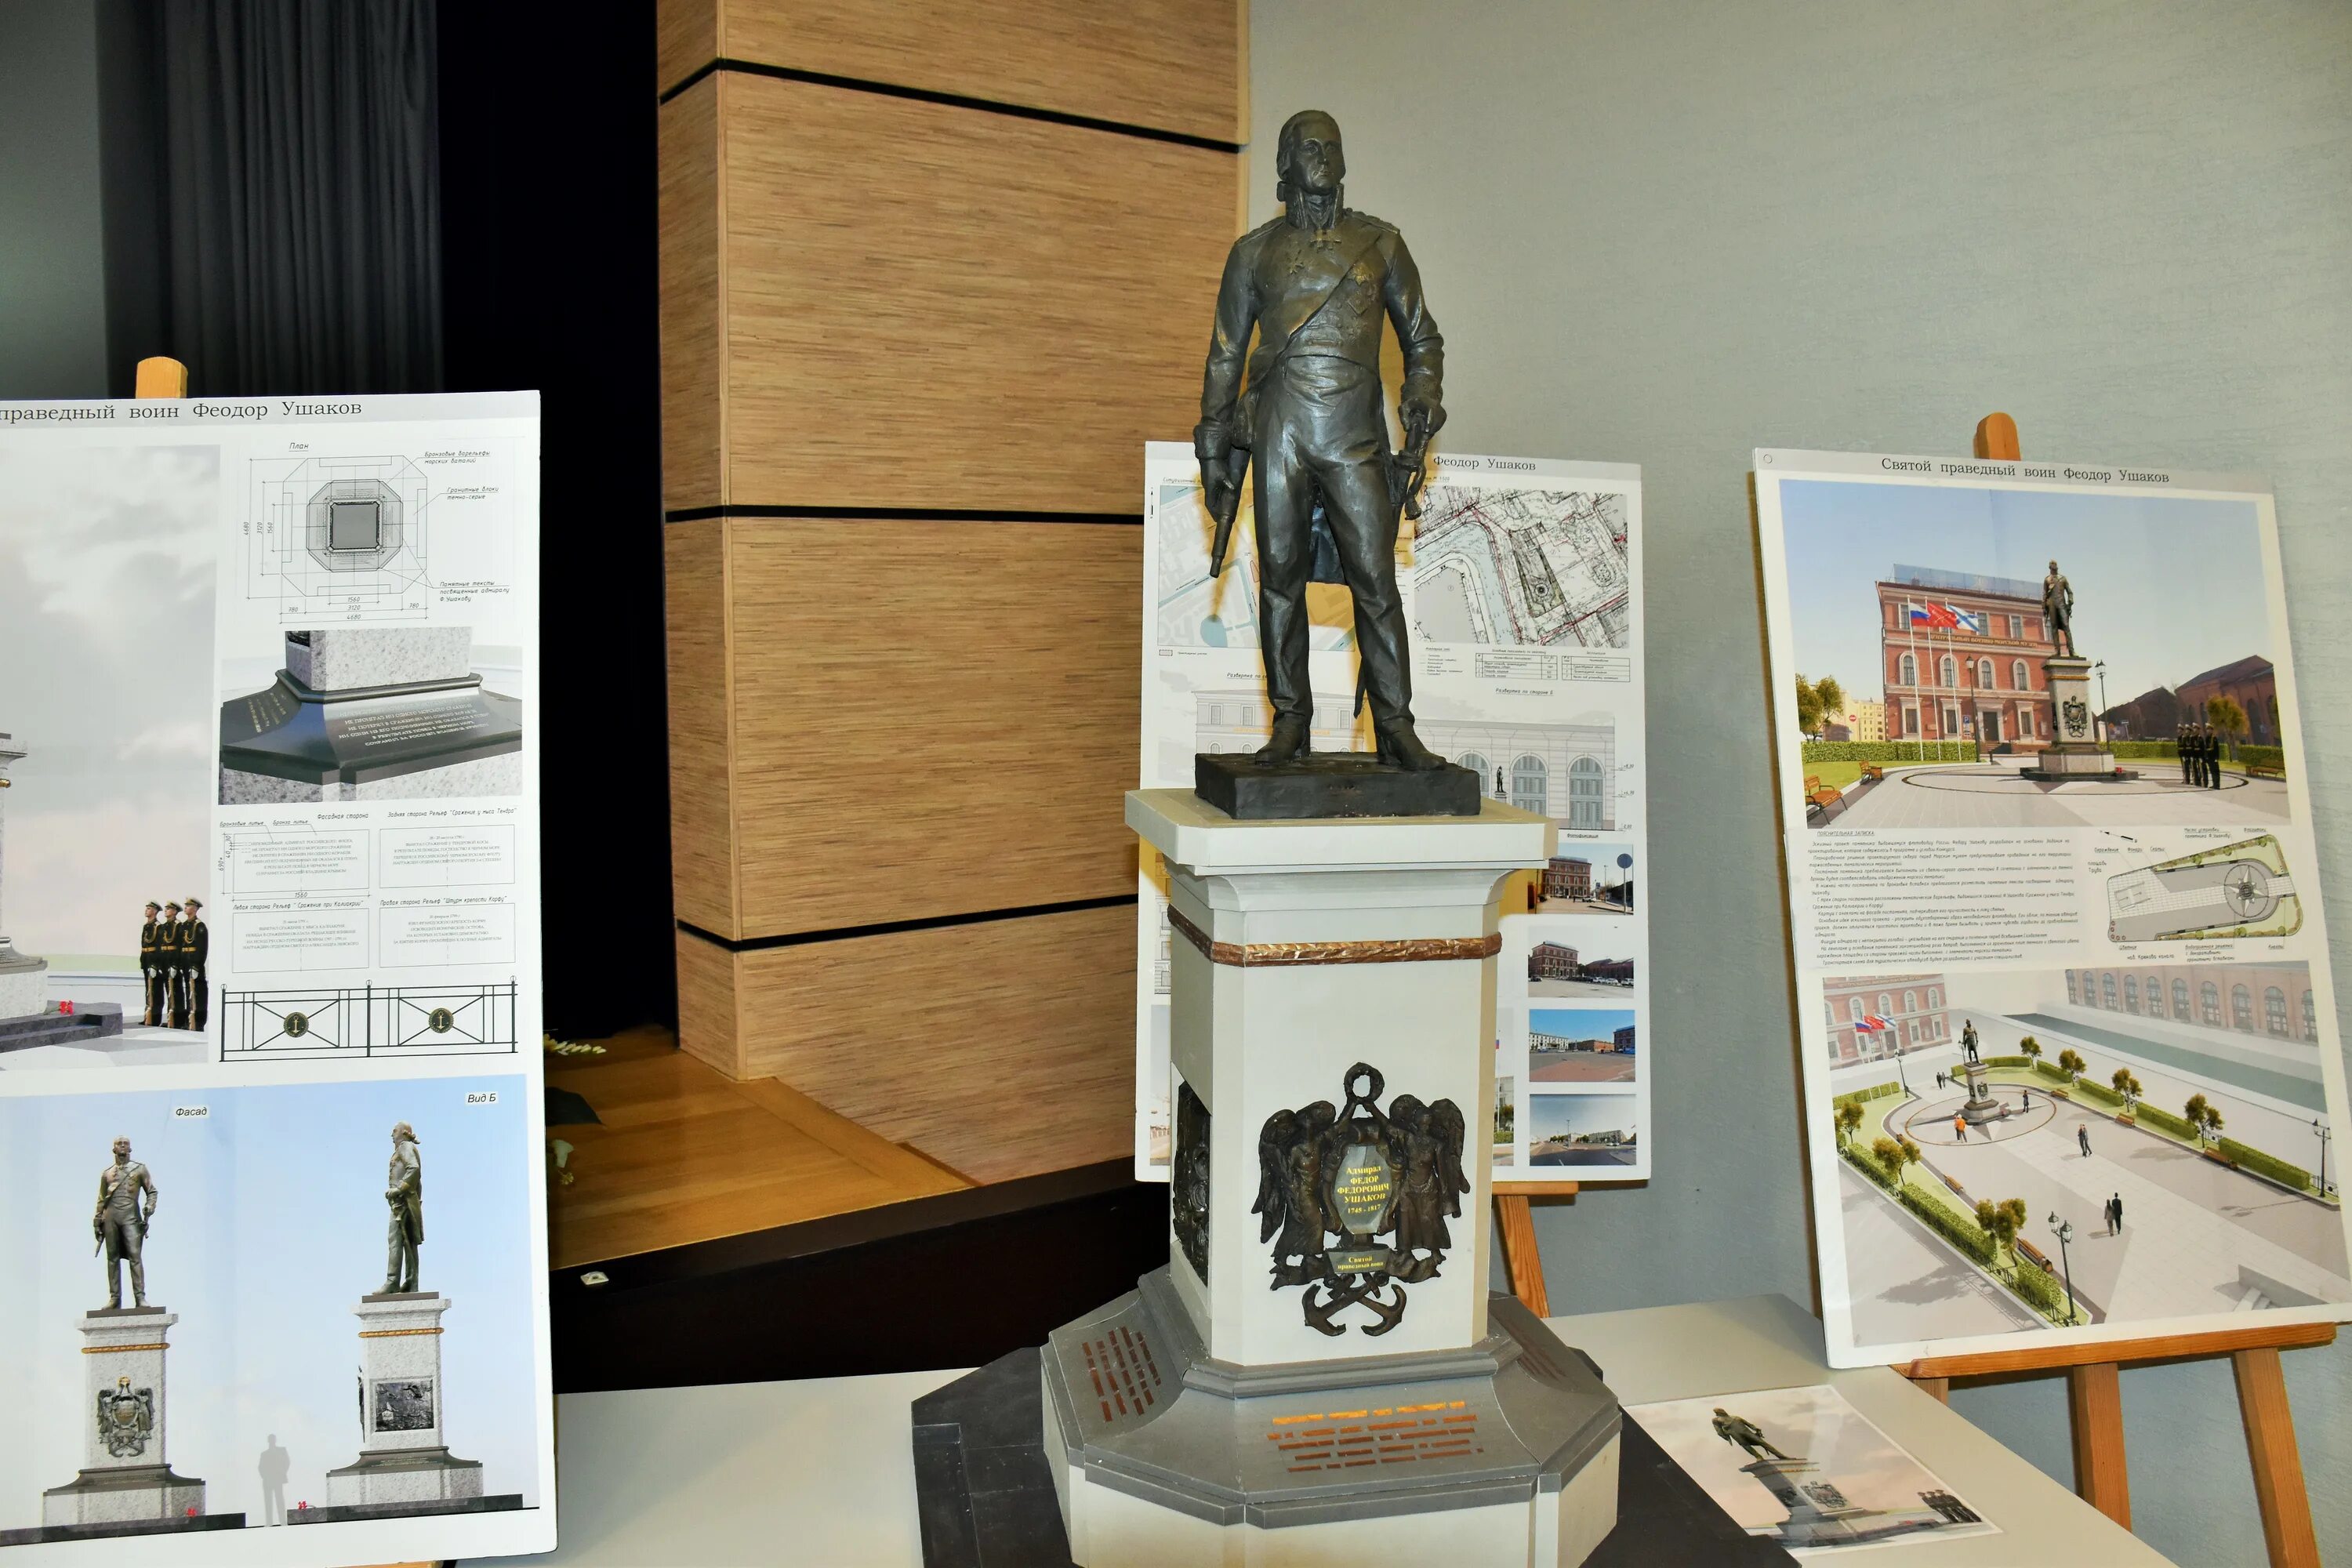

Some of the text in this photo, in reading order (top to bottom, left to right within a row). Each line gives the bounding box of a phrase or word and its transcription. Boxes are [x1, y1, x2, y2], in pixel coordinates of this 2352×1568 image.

[0, 401, 361, 424] праведный воин Феодор Ушаков
[1433, 456, 1536, 470] Феодор Ушаков
[1882, 458, 2169, 483] Святой праведный воин Феодор Ушаков
[467, 1094, 496, 1104] Вид Б
[176, 1106, 208, 1117] Фасад
[1346, 1166, 1381, 1175] Адмирал
[1350, 1175, 1379, 1185] ФЕДОР
[1338, 1183, 1389, 1195] ФЕДОРОВИЧ
[1345, 1192, 1386, 1203] УШАКОВ
